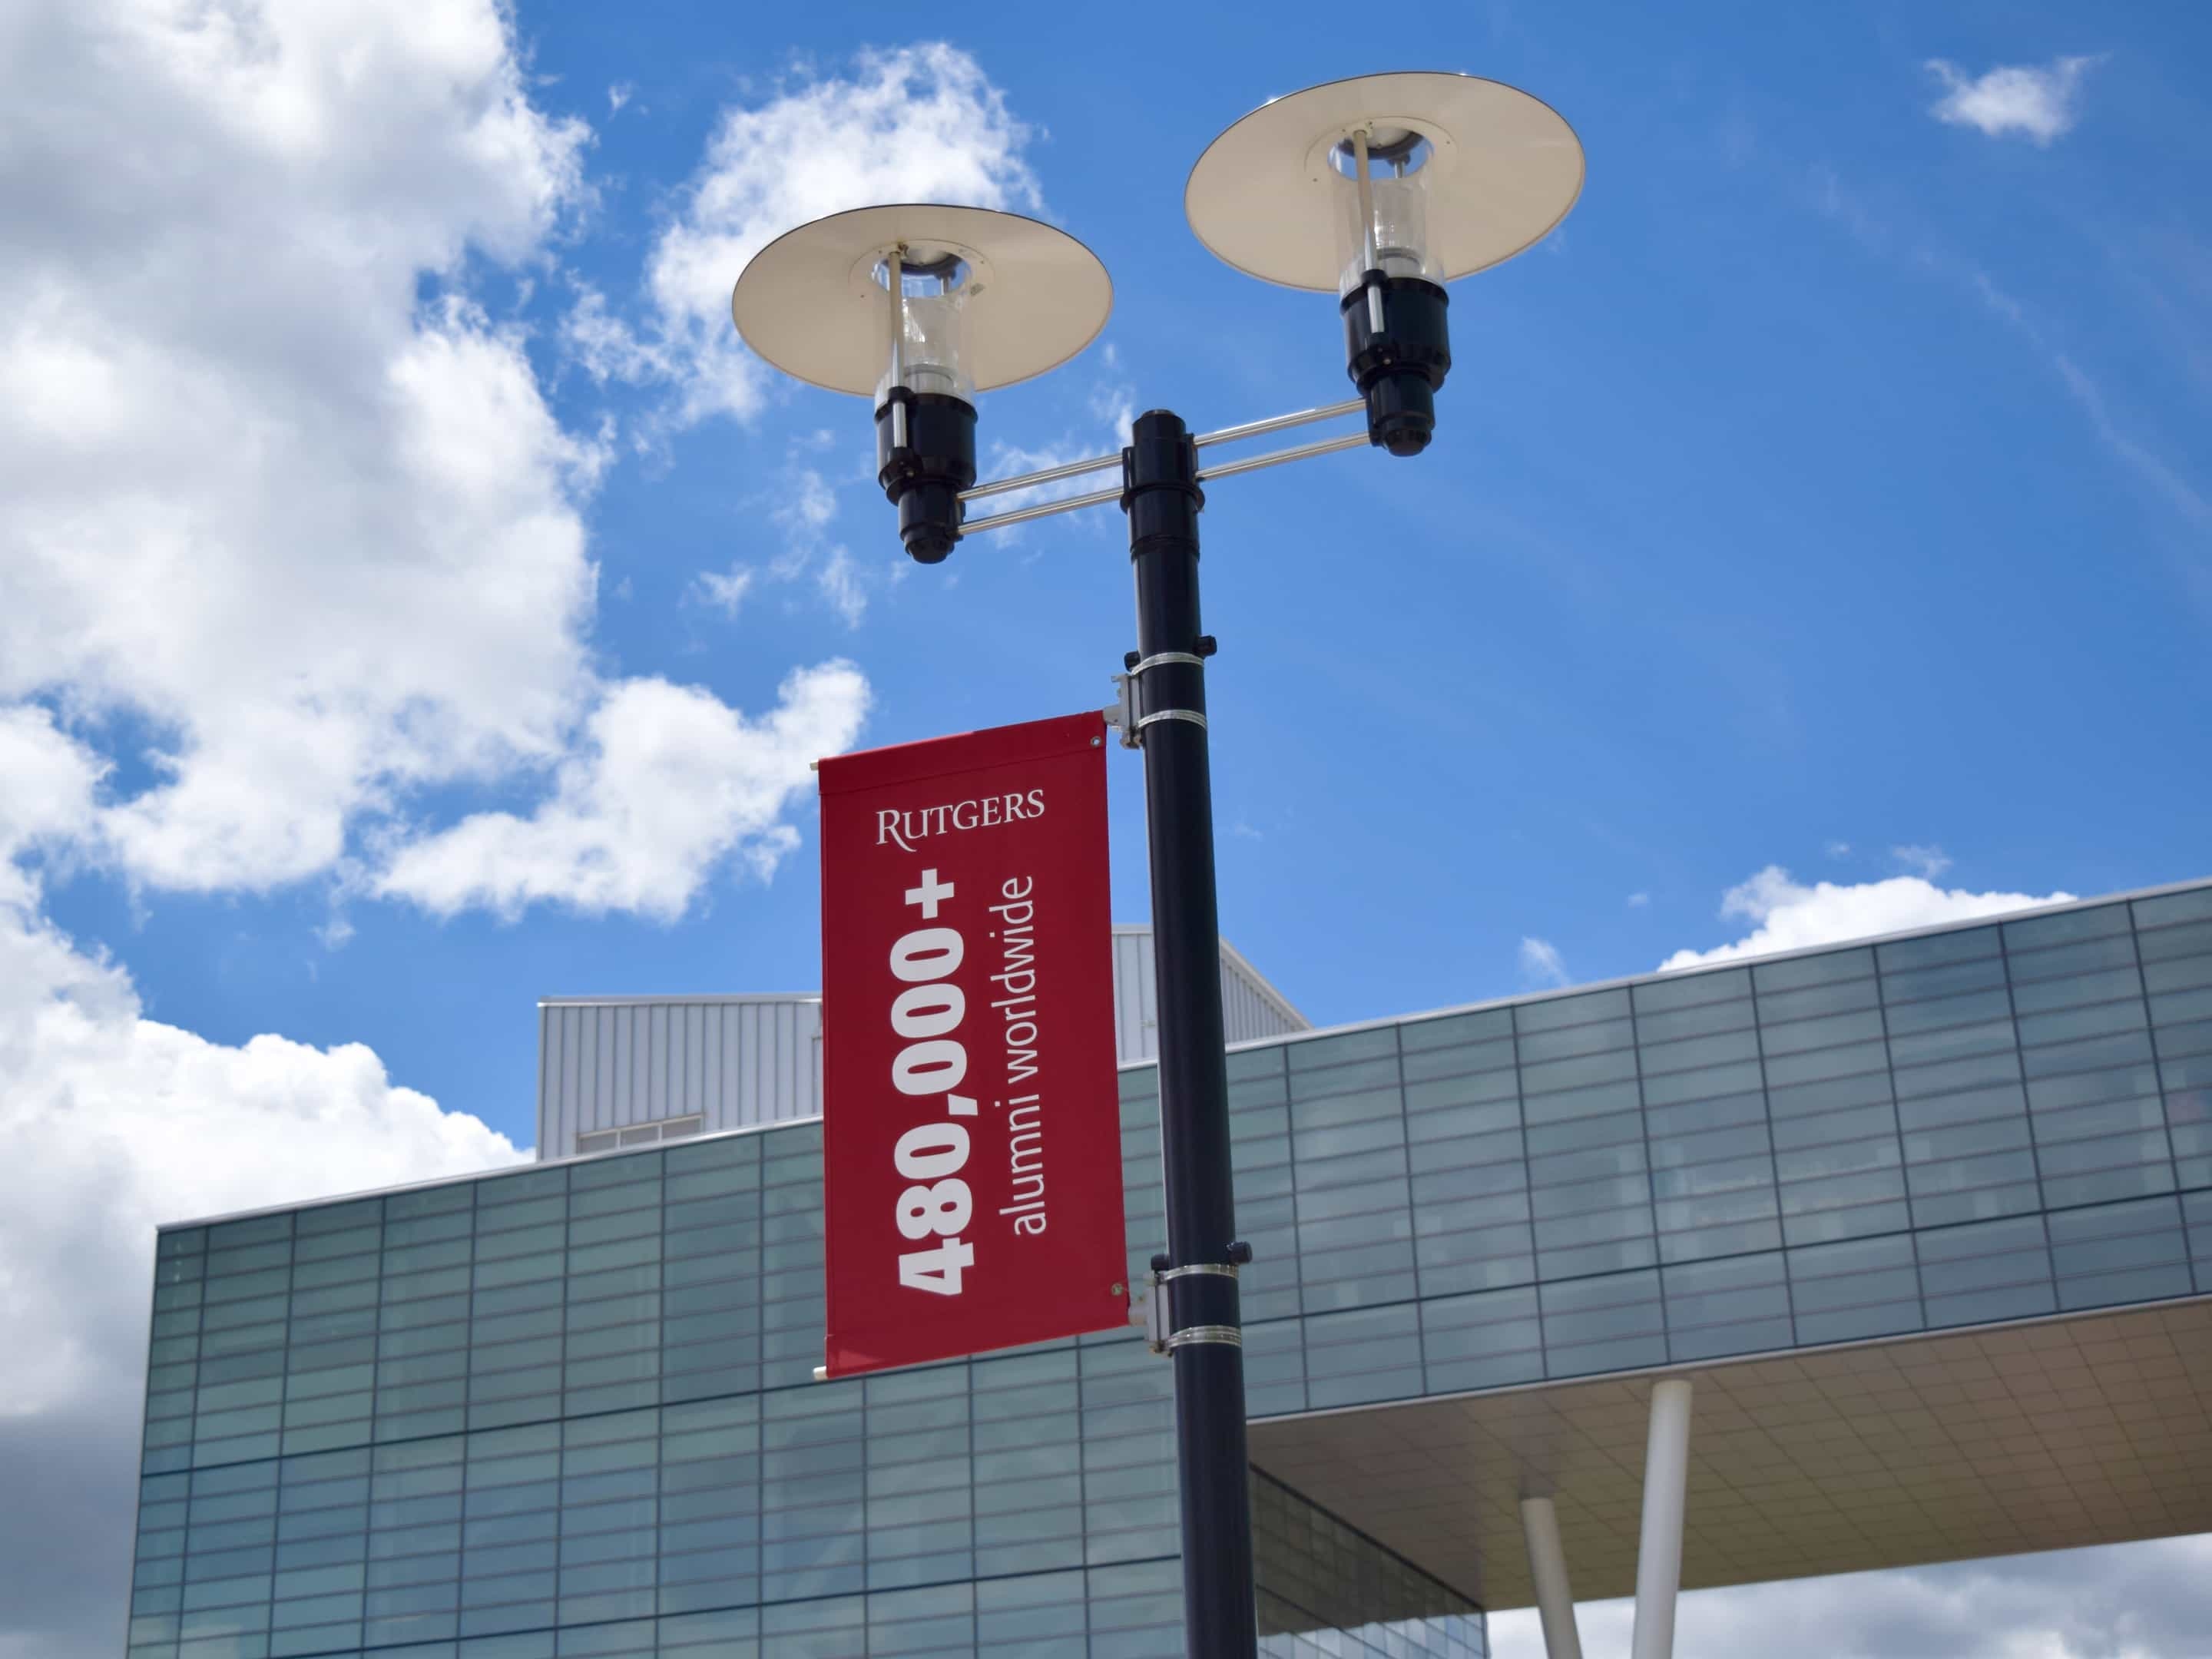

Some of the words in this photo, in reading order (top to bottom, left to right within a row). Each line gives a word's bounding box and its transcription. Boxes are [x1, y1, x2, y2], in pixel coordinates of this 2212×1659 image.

[876, 789, 1045, 853] RUTGERS
[988, 876, 1038, 1084] worldwide
[889, 867, 979, 1296] 480,000+
[994, 1093, 1047, 1236] alumni
